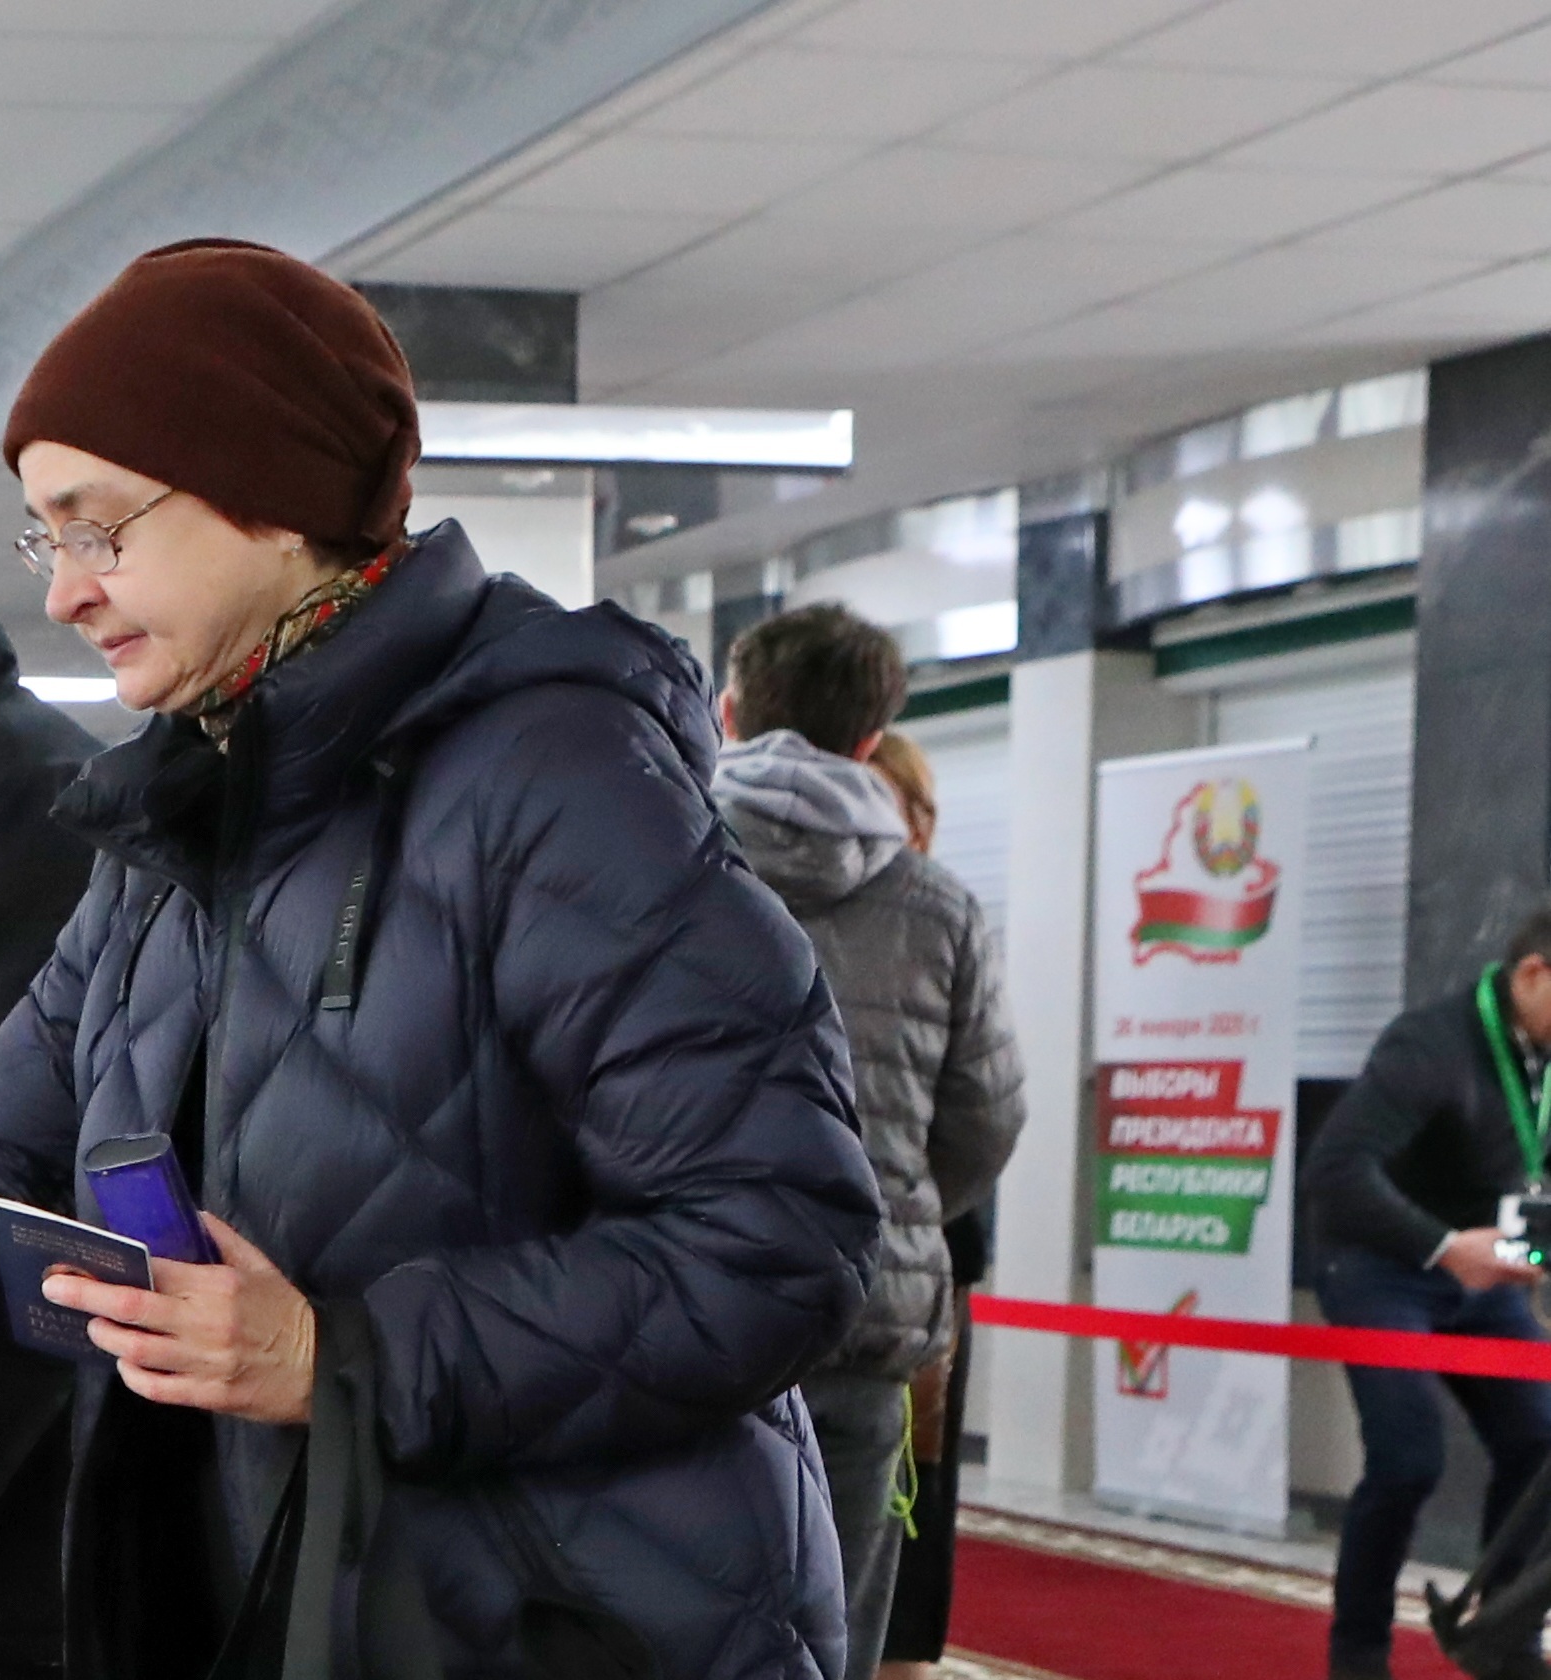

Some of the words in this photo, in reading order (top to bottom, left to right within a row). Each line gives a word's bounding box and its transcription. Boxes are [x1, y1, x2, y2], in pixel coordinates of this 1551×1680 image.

[1110, 1067, 1221, 1100] ВЫБОРЫ
[1109, 1115, 1265, 1149] ПРЕЗИДЕНТА
[1110, 1163, 1267, 1198] РЕСПУБЛИКИ
[1110, 1210, 1230, 1245] БЕЛАРУСЬ
